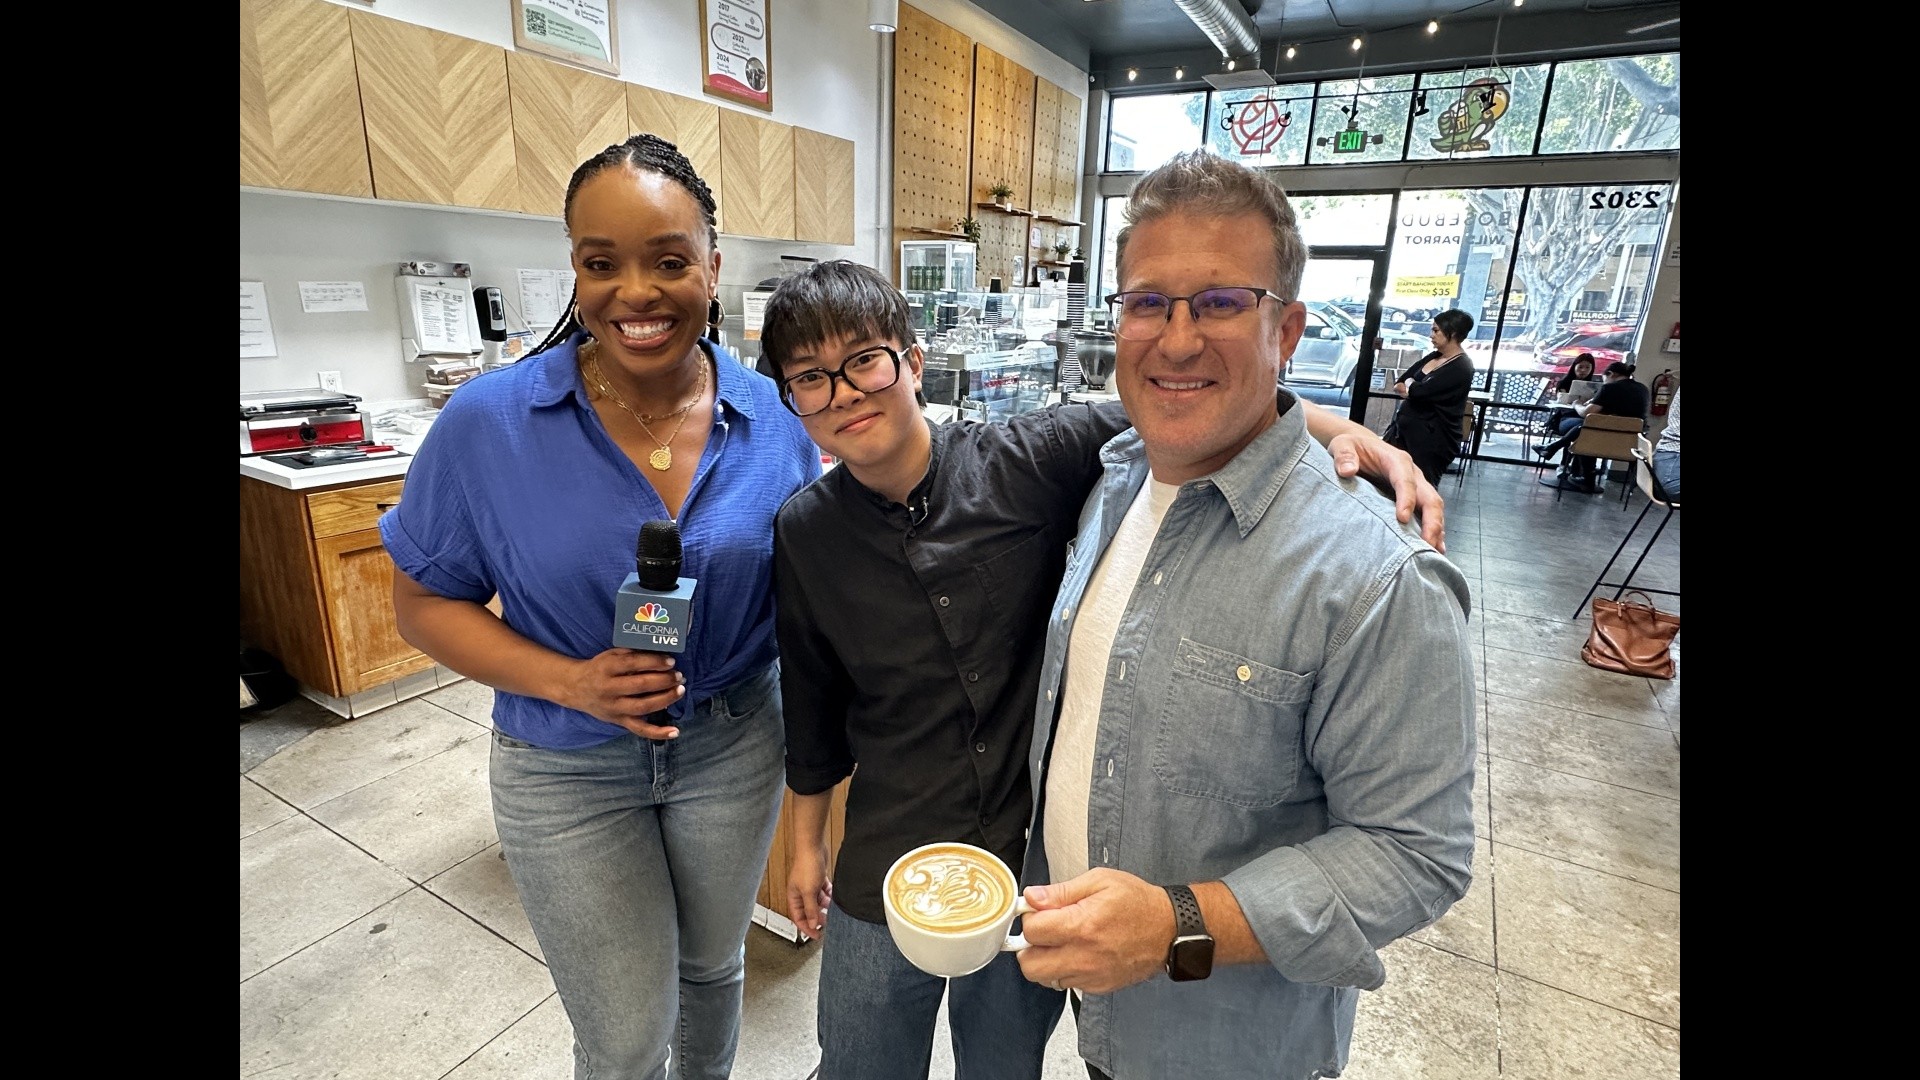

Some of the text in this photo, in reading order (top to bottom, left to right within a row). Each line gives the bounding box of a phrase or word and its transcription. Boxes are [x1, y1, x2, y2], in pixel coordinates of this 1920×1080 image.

[718, 2, 730, 11] 2017
[732, 33, 745, 43] 2022
[716, 53, 730, 63] 2024
[1338, 132, 1363, 150] EXIT
[1432, 287, 1450, 297] $35
[1573, 312, 1617, 320] BALLROOM
[622, 622, 679, 636] CALIFORNIA
